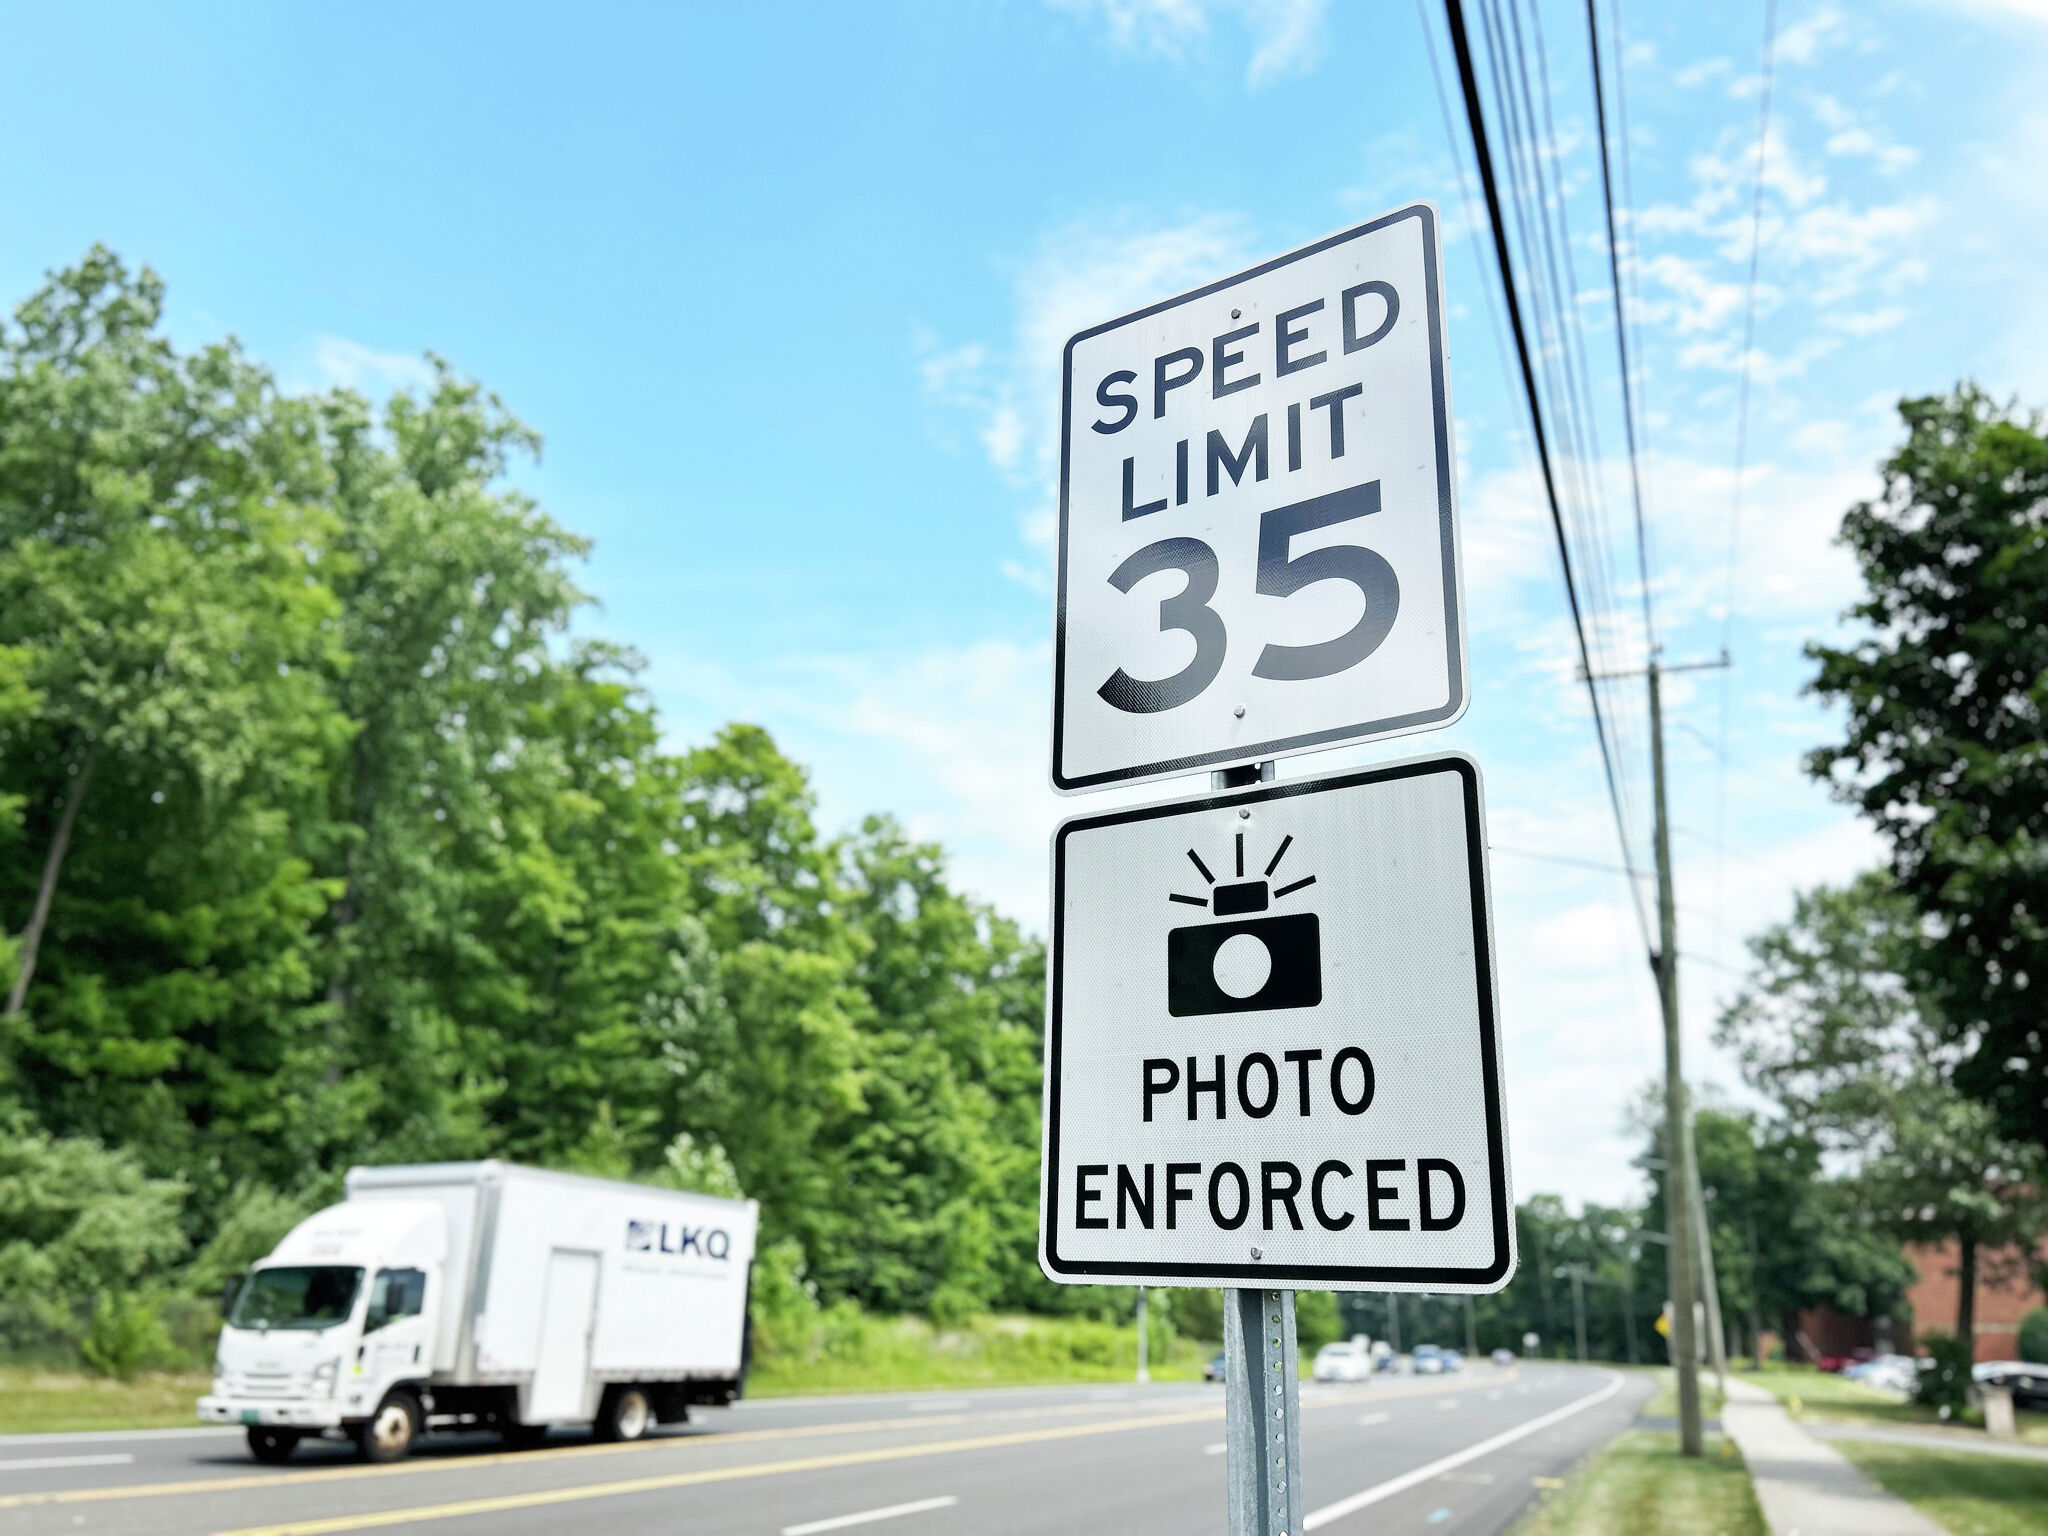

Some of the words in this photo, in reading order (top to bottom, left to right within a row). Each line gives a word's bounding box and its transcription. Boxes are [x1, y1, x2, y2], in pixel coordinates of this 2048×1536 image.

[1091, 280, 1400, 435] SPEED
[1122, 382, 1363, 522] LIMIT
[1096, 479, 1400, 714] 35
[1142, 1046, 1375, 1122] PHOTO
[659, 1223, 730, 1260] LKQ
[1075, 1157, 1466, 1232] ENFORCED
